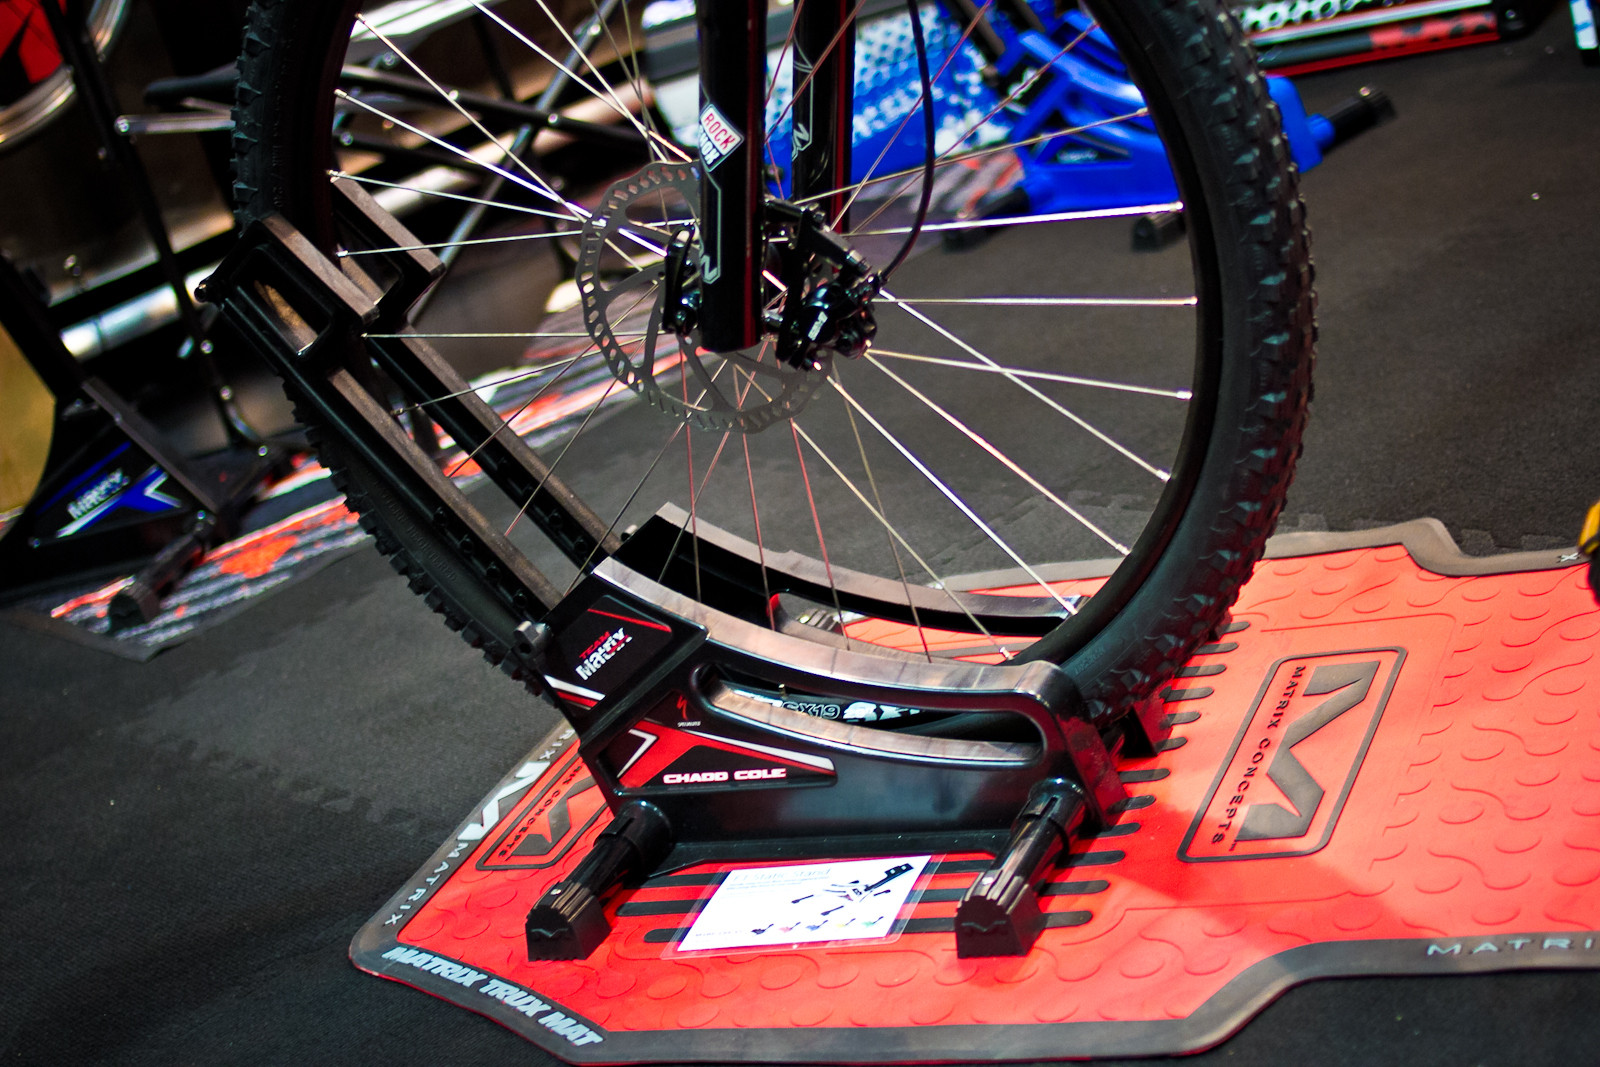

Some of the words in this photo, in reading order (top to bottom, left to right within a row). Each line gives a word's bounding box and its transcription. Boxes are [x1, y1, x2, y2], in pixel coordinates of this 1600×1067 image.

[700, 124, 720, 165] HOX
[704, 112, 736, 150] ROCK
[578, 630, 612, 660] TEAM
[1267, 665, 1306, 730] MATRIX
[539, 728, 576, 761] RIX
[662, 771, 729, 784] CHADD
[733, 767, 787, 781] COLE
[1211, 737, 1271, 845] CONCEPTS
[498, 789, 561, 859] CONCEPTS
[384, 842, 469, 926] MATRIX
[1427, 938, 1593, 956] MATRI
[381, 946, 488, 987] MATRIX
[479, 978, 552, 1018] TRUX
[538, 1011, 603, 1047] MAT
